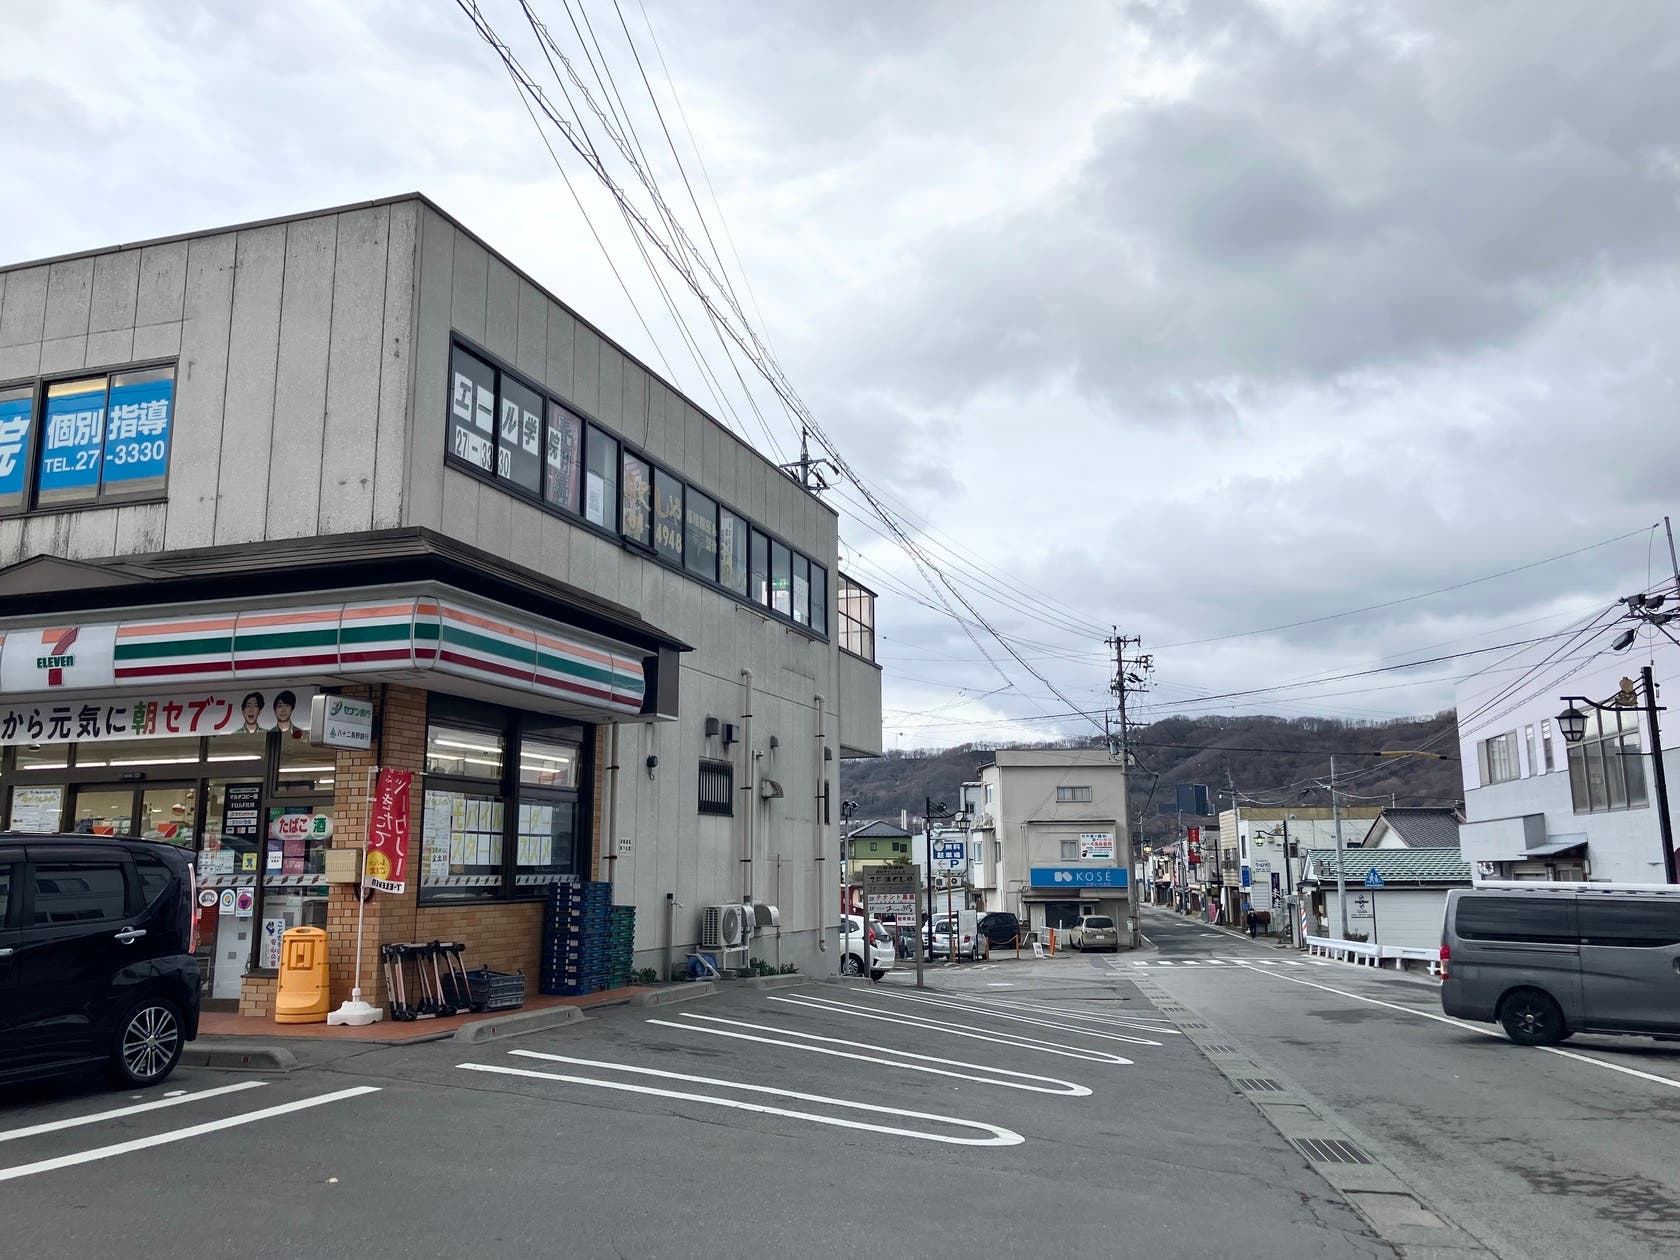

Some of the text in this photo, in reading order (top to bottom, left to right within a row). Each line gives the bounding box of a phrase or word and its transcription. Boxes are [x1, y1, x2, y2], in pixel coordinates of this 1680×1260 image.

[47, 399, 169, 450] 個別指導
[454, 381, 560, 460] エール学院
[1, 695, 233, 742] から元気に朝セブン
[343, 706, 371, 719] セブン銀行
[337, 729, 369, 741] 八十二長野銀行
[279, 817, 327, 833] たばこ 酒
[950, 859, 960, 869] P
[1075, 869, 1112, 882] KOSÉ
